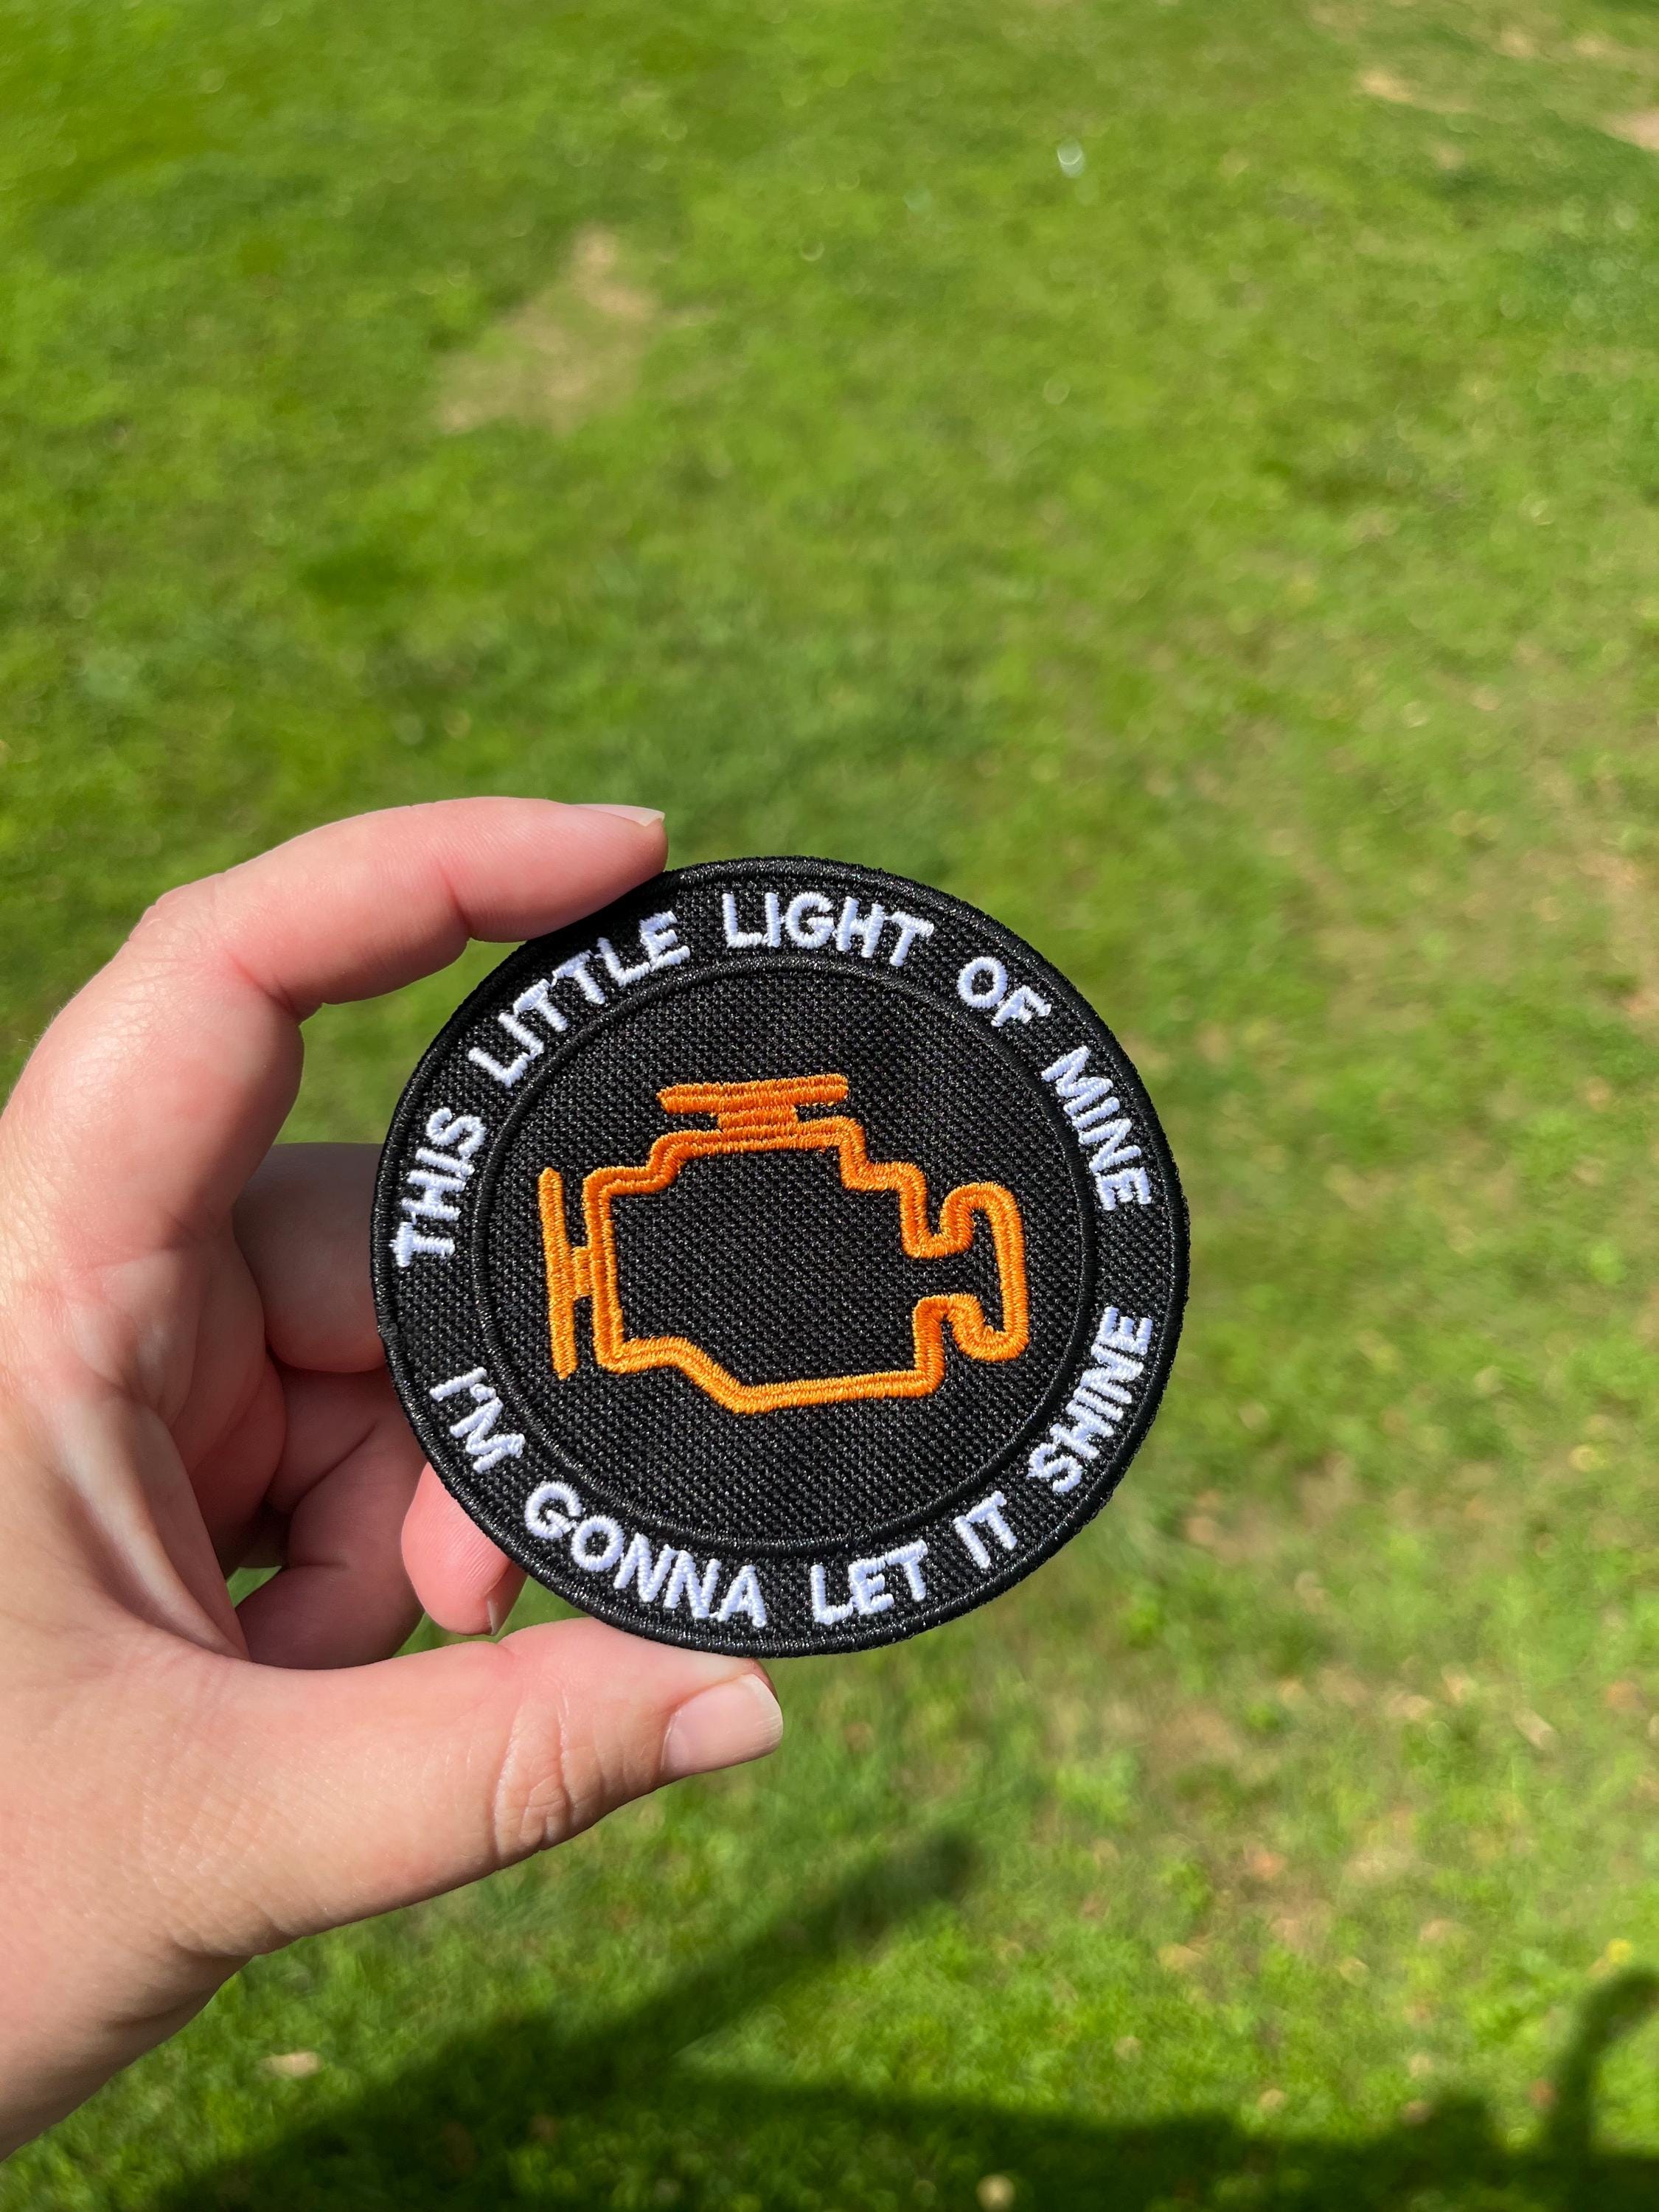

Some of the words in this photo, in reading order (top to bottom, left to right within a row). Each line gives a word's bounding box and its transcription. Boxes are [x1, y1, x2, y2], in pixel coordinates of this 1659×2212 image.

[390, 1108, 487, 1267] THIS
[467, 911, 689, 1088] LITTLE
[720, 891, 936, 968] LIGHT
[956, 957, 1052, 1029] OF
[1041, 1043, 1154, 1211] MINE
[429, 1366, 524, 1473] I'M
[522, 1479, 767, 1629] GONNA
[810, 1539, 929, 1627] LET
[950, 1491, 1018, 1572] IT
[1026, 1306, 1154, 1495] SHINE
